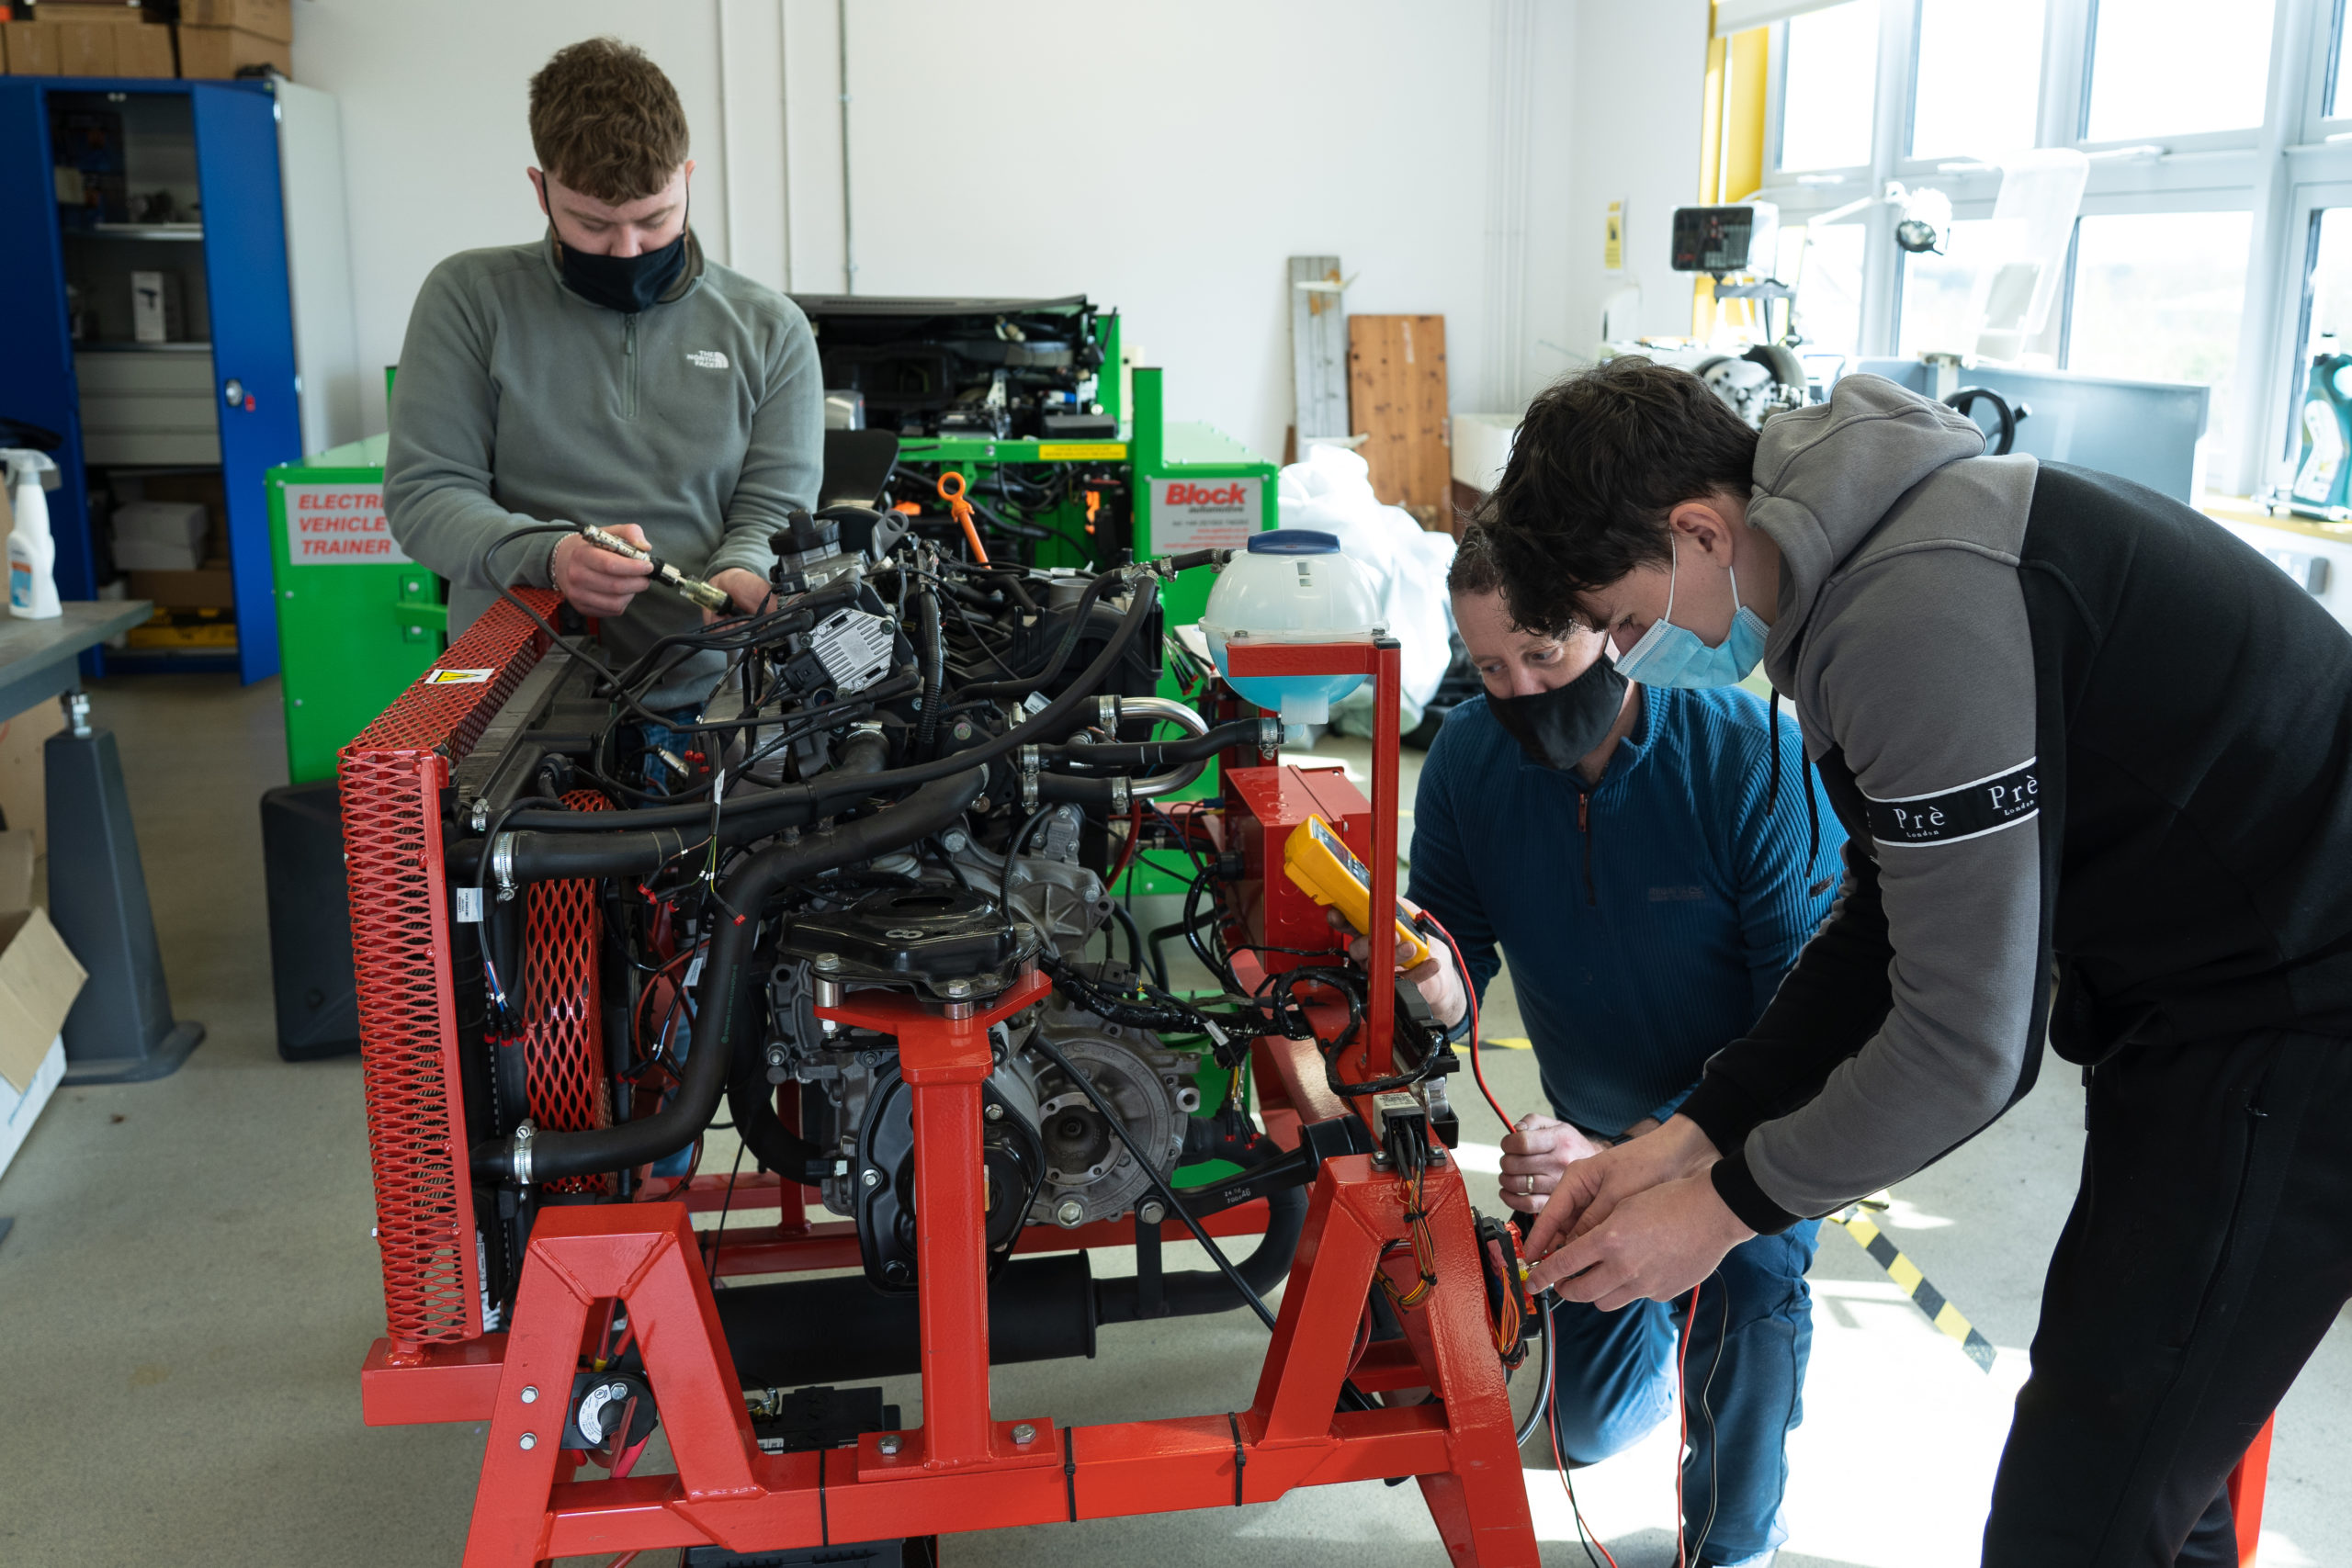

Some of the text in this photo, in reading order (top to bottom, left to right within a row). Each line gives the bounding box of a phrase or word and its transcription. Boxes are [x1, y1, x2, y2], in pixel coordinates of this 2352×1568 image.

[298, 494, 384, 510] ELECTRI
[1165, 482, 1247, 505] Block
[299, 515, 387, 532] VEHICLE
[301, 539, 392, 555] TRAINER
[1893, 806, 1946, 829] Prè
[1988, 774, 2038, 810] Prè
[2004, 799, 2035, 816] London
[1906, 829, 1939, 838] London
